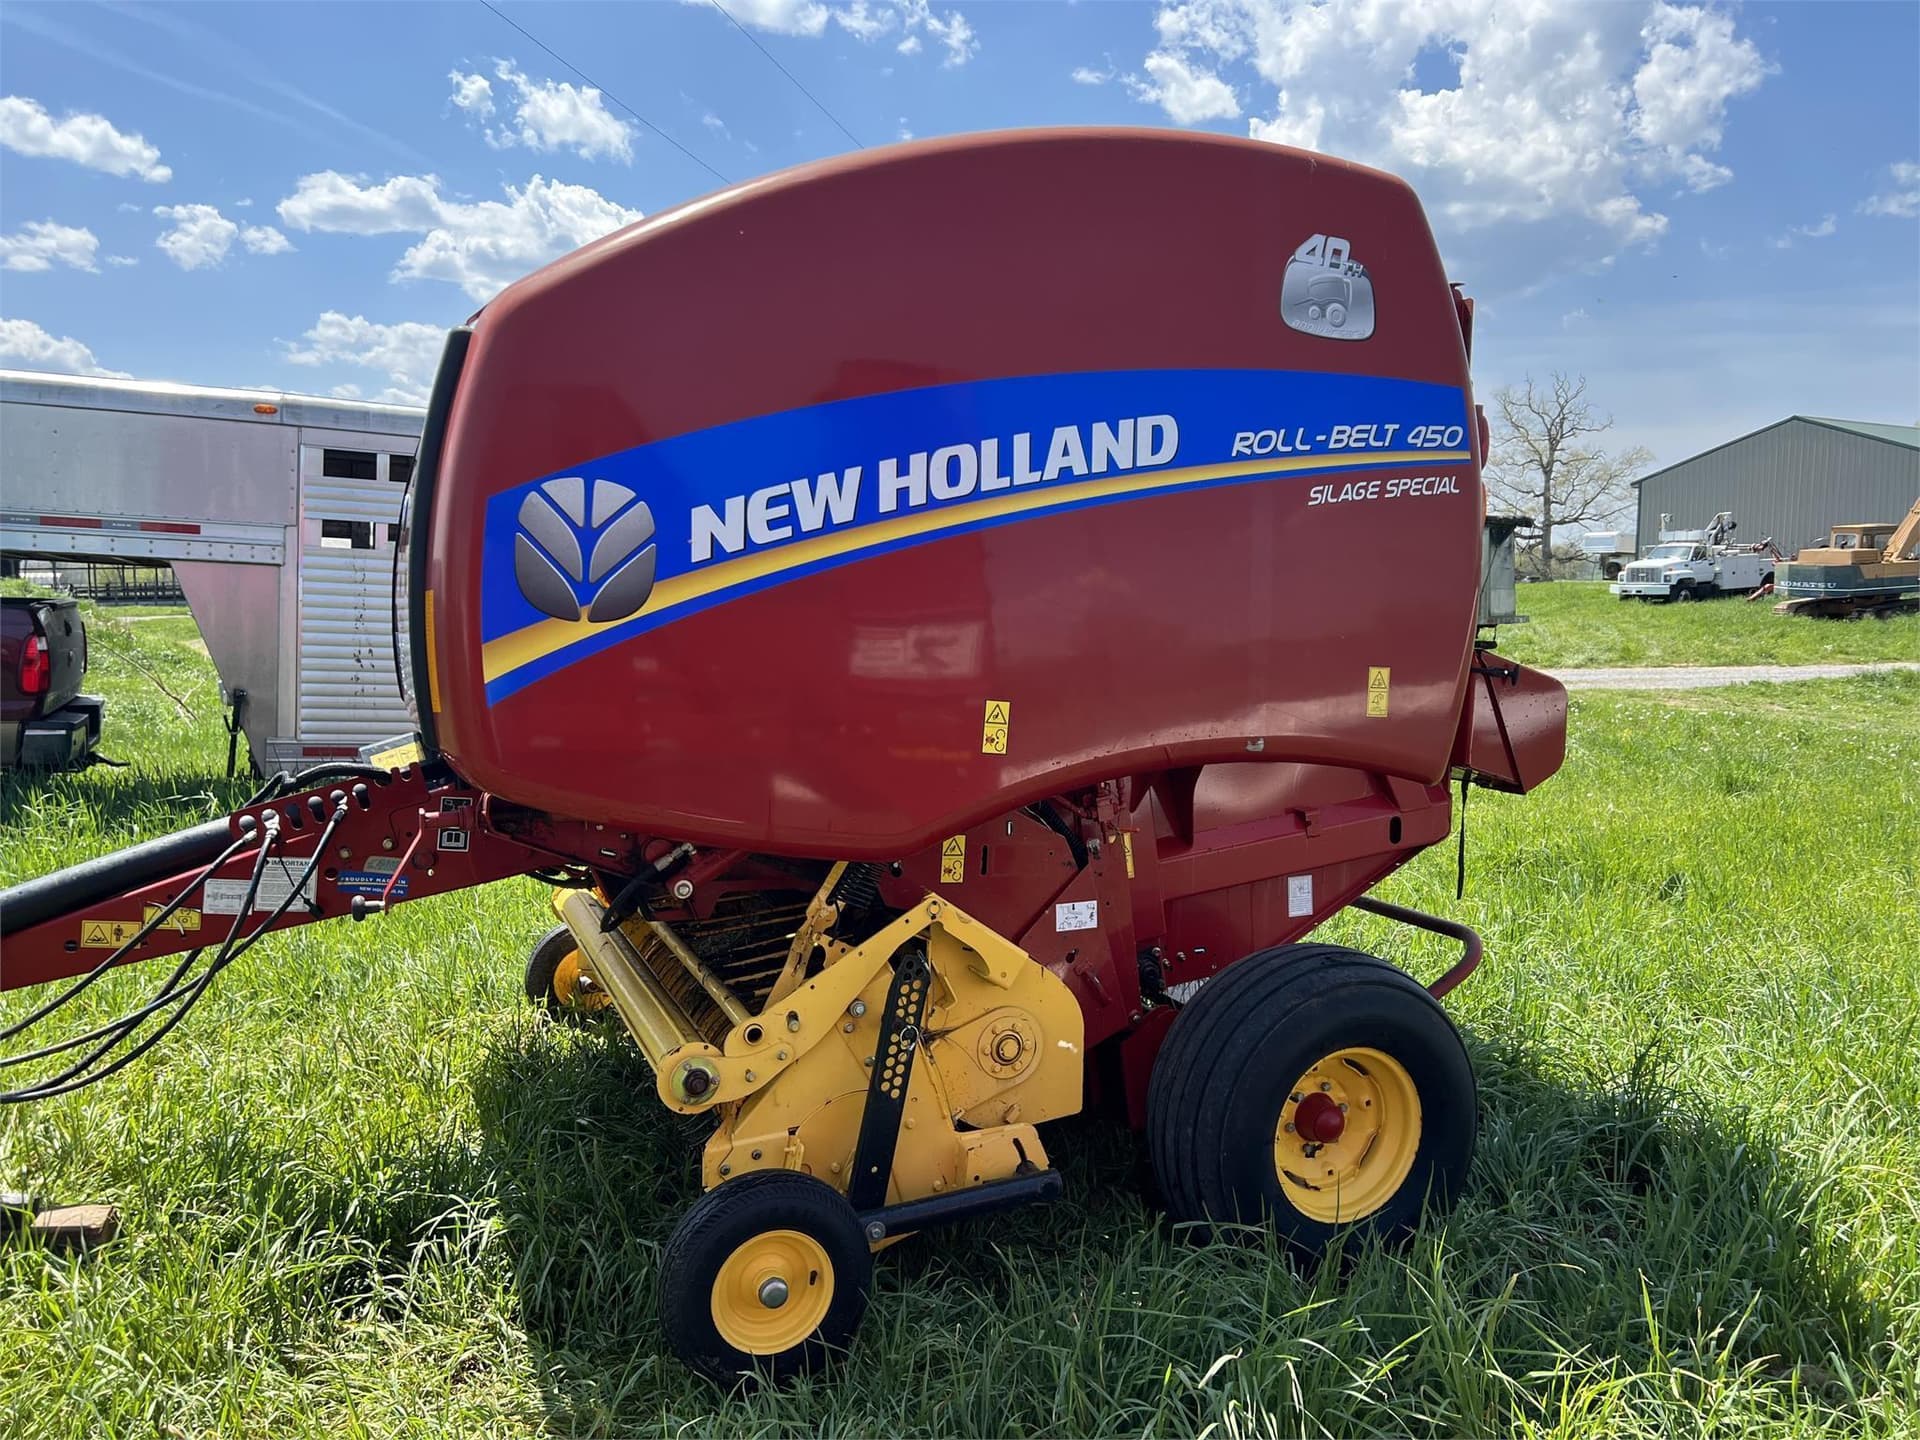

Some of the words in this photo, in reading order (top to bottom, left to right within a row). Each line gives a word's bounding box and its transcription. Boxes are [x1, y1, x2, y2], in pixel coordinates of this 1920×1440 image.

[1407, 425, 1464, 448] 450
[690, 466, 863, 563] NEW
[878, 414, 1179, 513] HOLLAND
[1308, 480, 1381, 506] SILAGE
[1384, 476, 1460, 498] SPECIAL
[1780, 580, 1837, 588] KOMATSU
[271, 859, 311, 867] IMPORTAN
